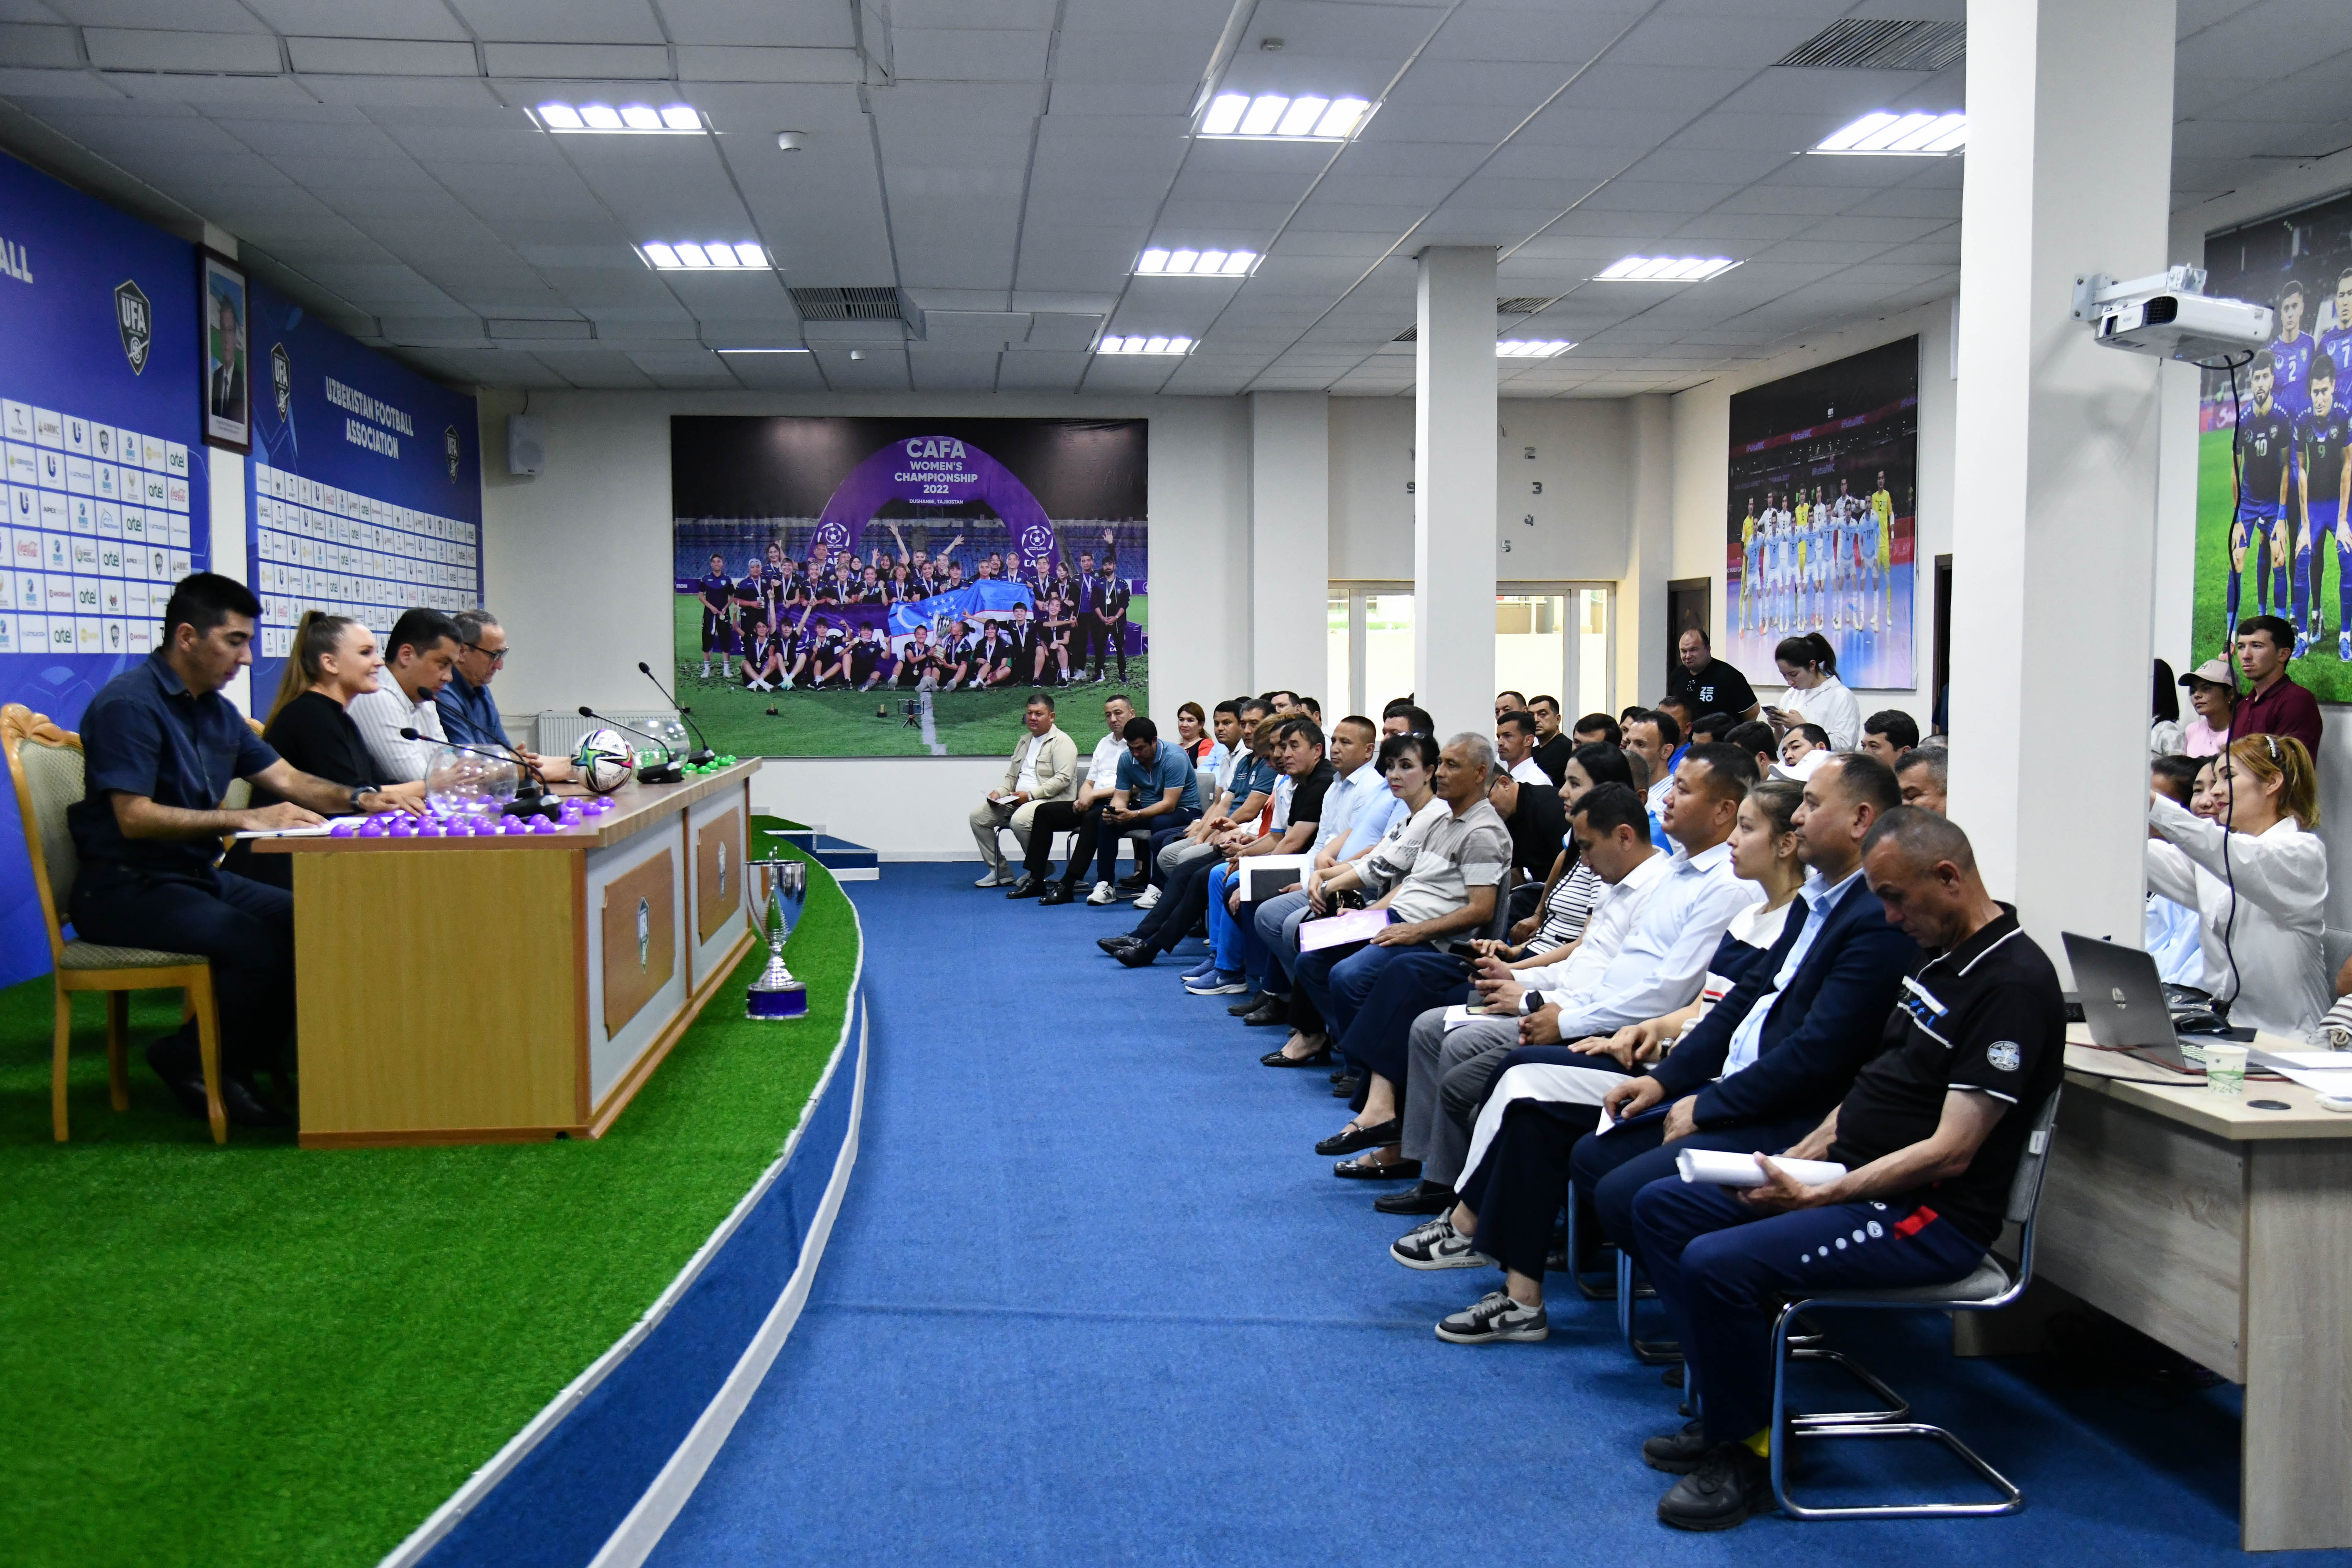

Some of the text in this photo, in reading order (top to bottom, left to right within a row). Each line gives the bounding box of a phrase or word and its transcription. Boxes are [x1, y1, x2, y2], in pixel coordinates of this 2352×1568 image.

[121, 297, 146, 333] UFA
[274, 357, 288, 386] UFA
[2288, 360, 2296, 382] 2
[326, 376, 414, 437] UZBEKISTAN FOOTBALL
[346, 417, 399, 460] ASSOCIATION
[907, 440, 967, 458] CAFA
[1525, 447, 1536, 459] 2
[2255, 439, 2267, 457] 10
[2317, 444, 2326, 458] 9
[910, 461, 963, 471] WOMEN'S
[895, 473, 978, 482] CHAMPIONSHIP
[924, 485, 949, 494] 2022
[1532, 482, 1542, 494] 3
[1501, 540, 1511, 553] 5
